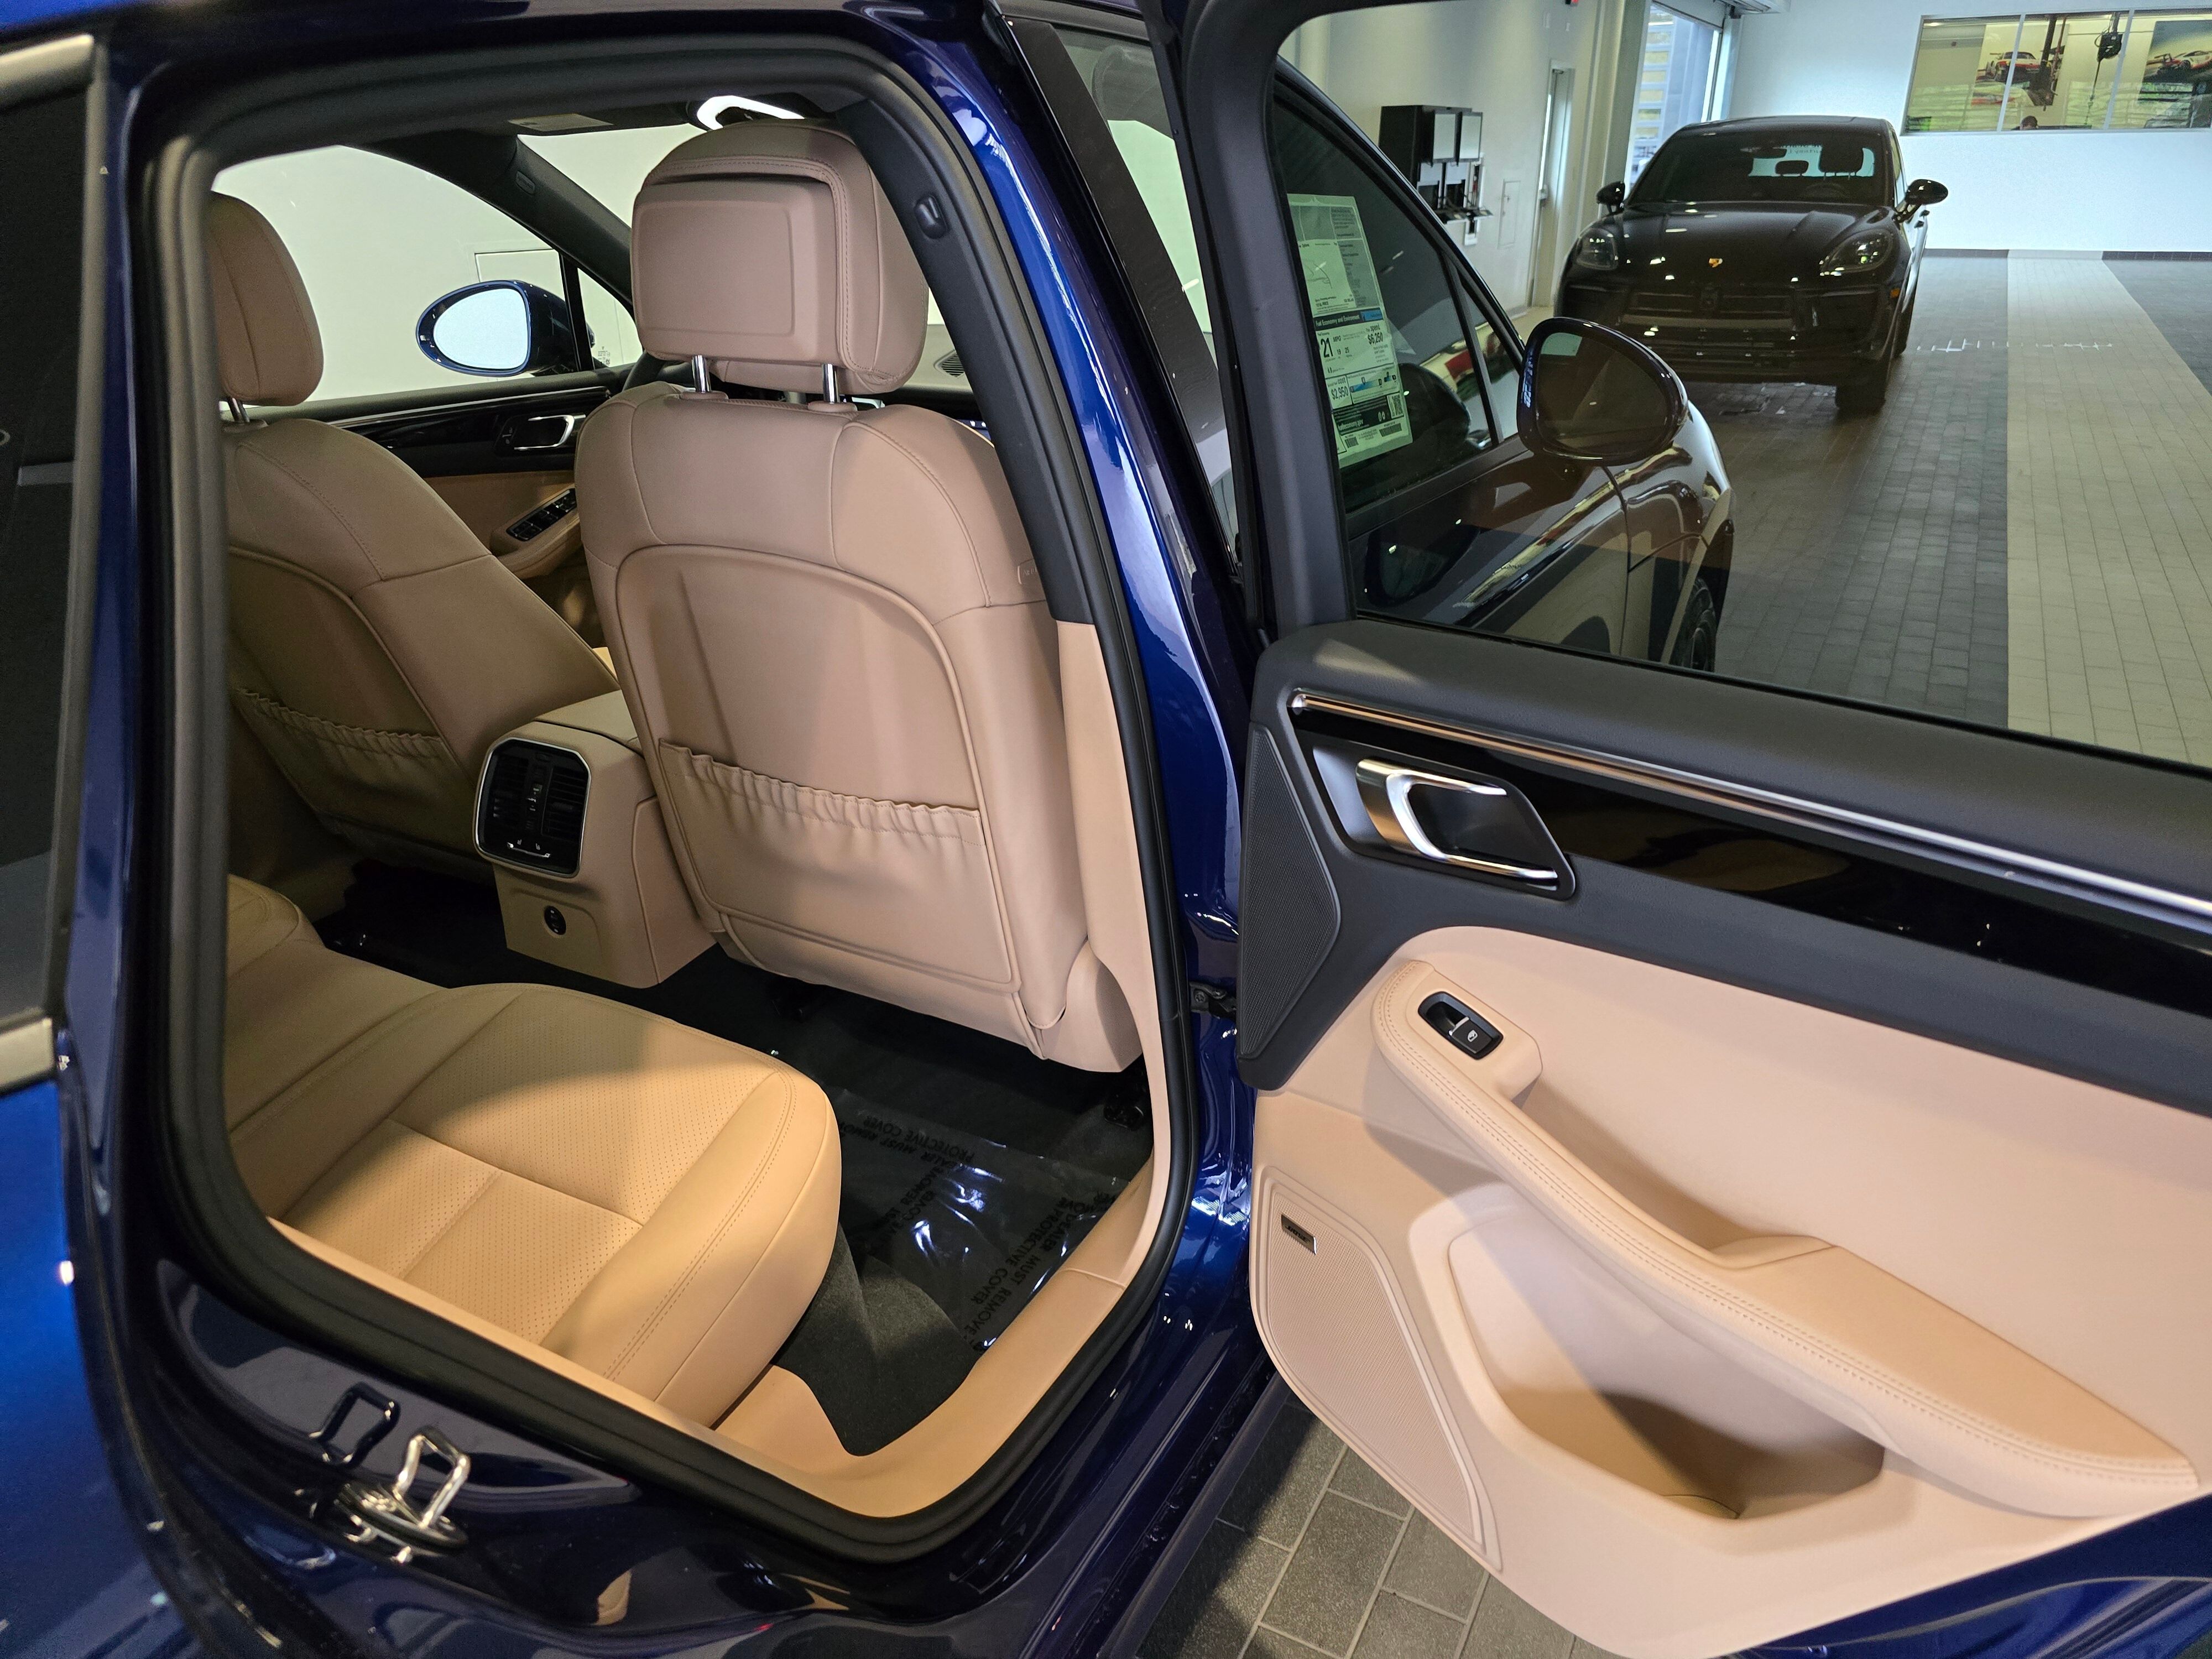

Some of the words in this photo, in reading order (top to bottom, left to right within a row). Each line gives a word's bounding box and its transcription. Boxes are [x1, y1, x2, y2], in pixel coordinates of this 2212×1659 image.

[1321, 337, 1333, 358] 21
[1368, 332, 1383, 345] $6,250
[1331, 387, 1349, 400] $2,950
[1005, 1208, 1064, 1267] PROTECTIVE
[970, 1267, 1008, 1305] COVER
[1011, 1254, 1041, 1286] MUST
[965, 1287, 1012, 1335] REMOVE
